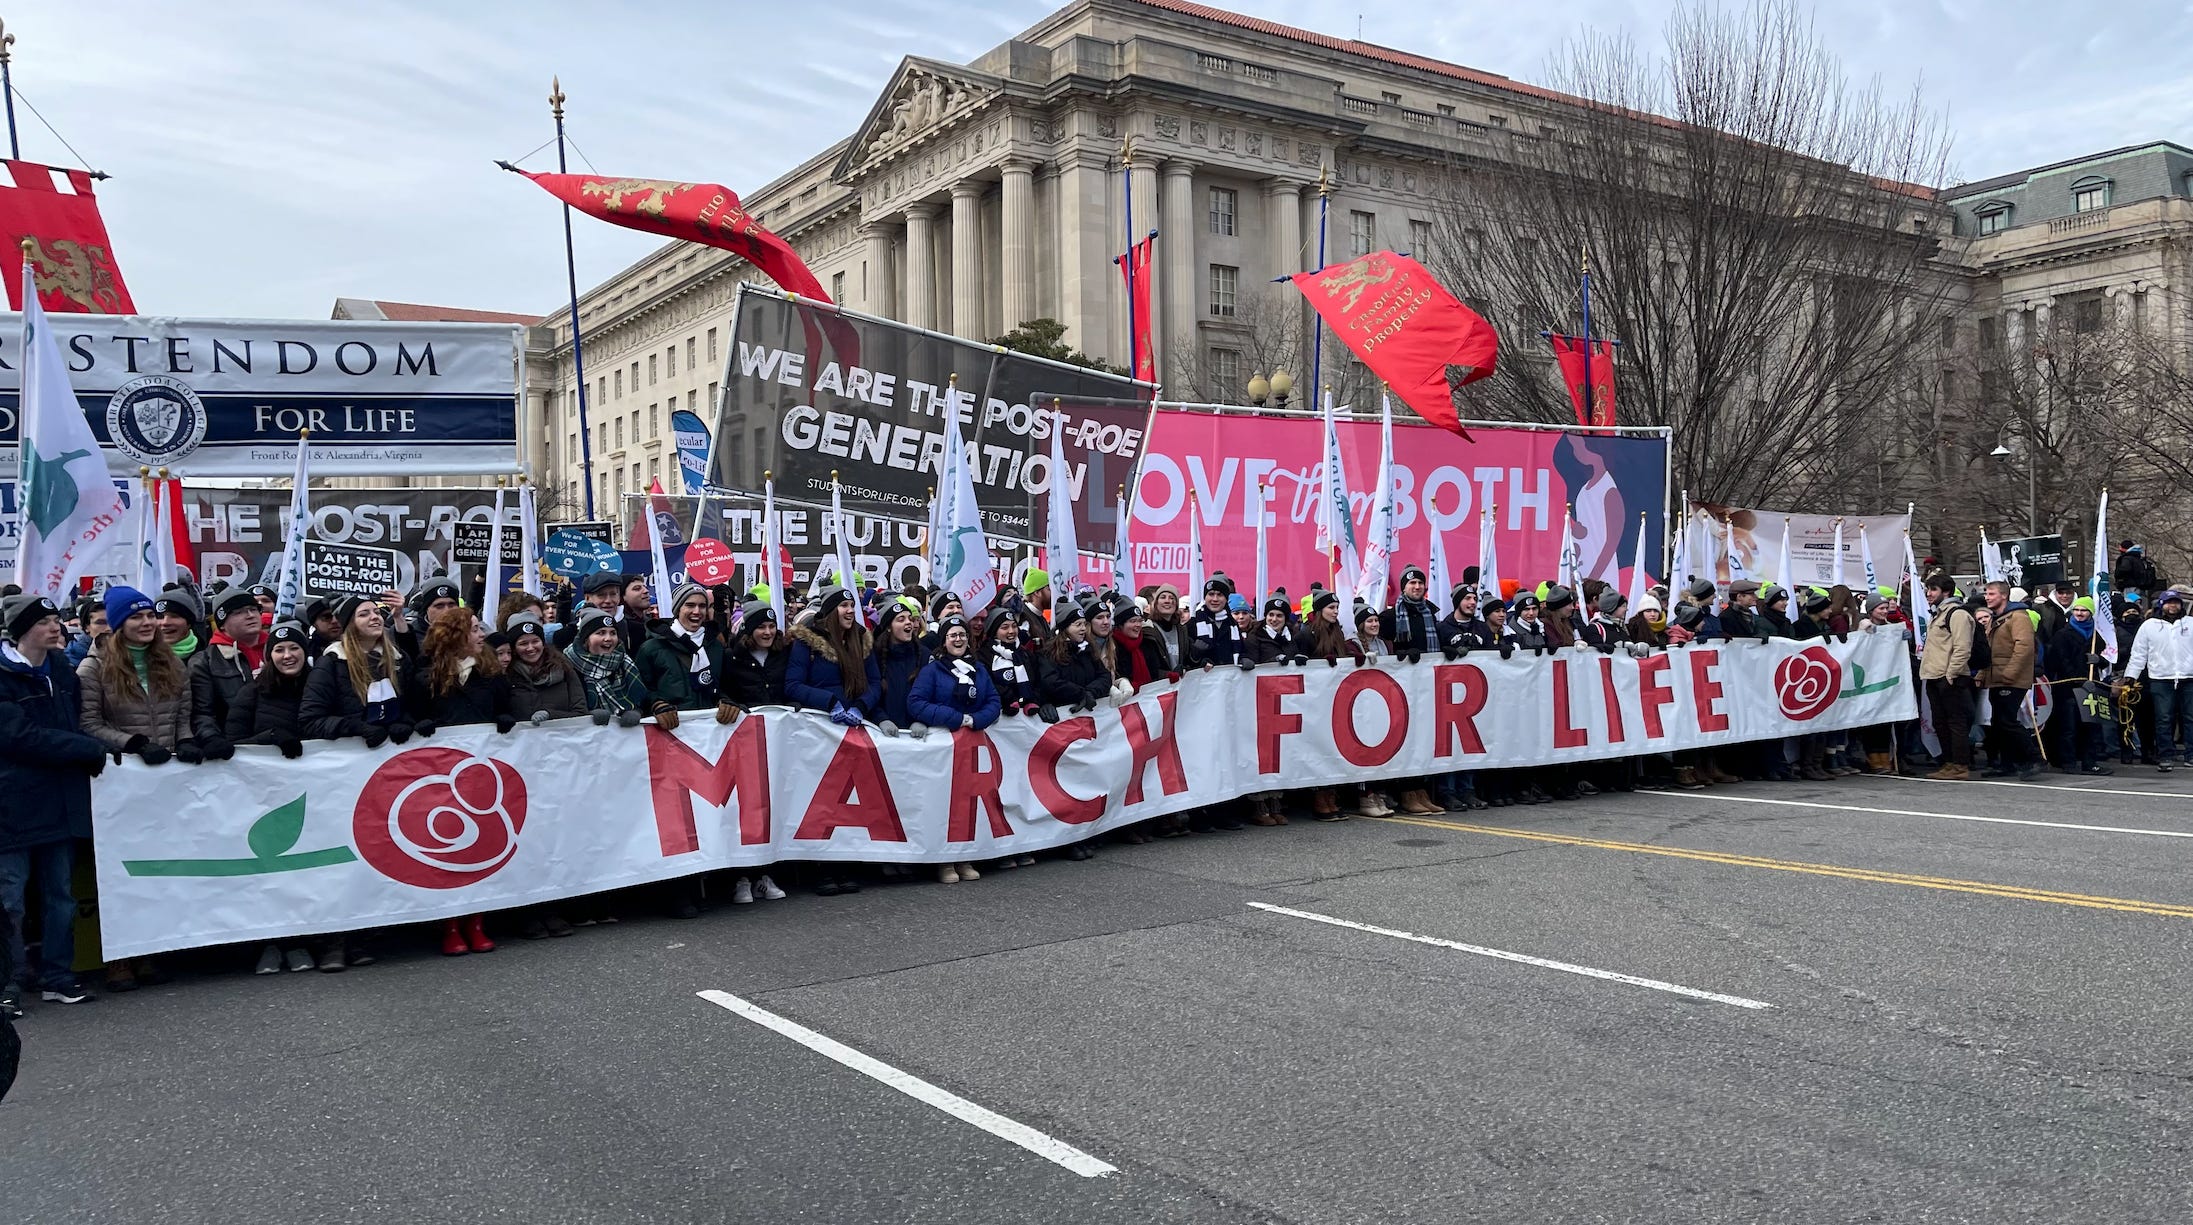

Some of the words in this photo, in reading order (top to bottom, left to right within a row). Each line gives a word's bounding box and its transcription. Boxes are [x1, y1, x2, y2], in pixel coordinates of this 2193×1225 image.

[0, 334, 442, 376] STENDOM
[738, 341, 806, 388] WE
[813, 361, 896, 407] ARE
[906, 379, 976, 424] THE
[983, 398, 1143, 458] POST-ROE
[253, 405, 333, 433] FOR
[343, 405, 416, 433] LIFE
[678, 435, 703, 447] ecular
[251, 451, 279, 460] Front
[282, 451, 311, 460] Rol
[314, 452, 323, 460] &
[384, 450, 422, 462] Virginia
[781, 405, 1088, 502] GENERATION
[682, 455, 706, 474] ro-Lif
[806, 478, 922, 508] STUDNTSFORLIFE.ORG
[1087, 451, 1277, 527] LOVE
[1268, 462, 1376, 526] thm
[1391, 464, 1550, 532] BOTH
[184, 504, 263, 542] HE
[722, 509, 808, 545] THE
[988, 512, 1001, 521] TO
[1002, 514, 1030, 527] 53445
[459, 529, 463, 537] I
[468, 530, 488, 538] AM
[501, 532, 518, 540] HE
[311, 551, 316, 561] I
[323, 553, 349, 564] AM
[356, 556, 387, 569] THE
[456, 548, 519, 559] GENERION
[545, 547, 566, 555] EVERY
[567, 550, 594, 559] WOMAN
[686, 559, 705, 569] EVERY
[706, 554, 733, 565] WOMAN
[307, 562, 393, 582] POST-ROE
[309, 577, 391, 594] GENERATION
[644, 690, 1189, 857] MARCH
[1256, 664, 1489, 774] FOR
[1552, 650, 1730, 749] LIFE
